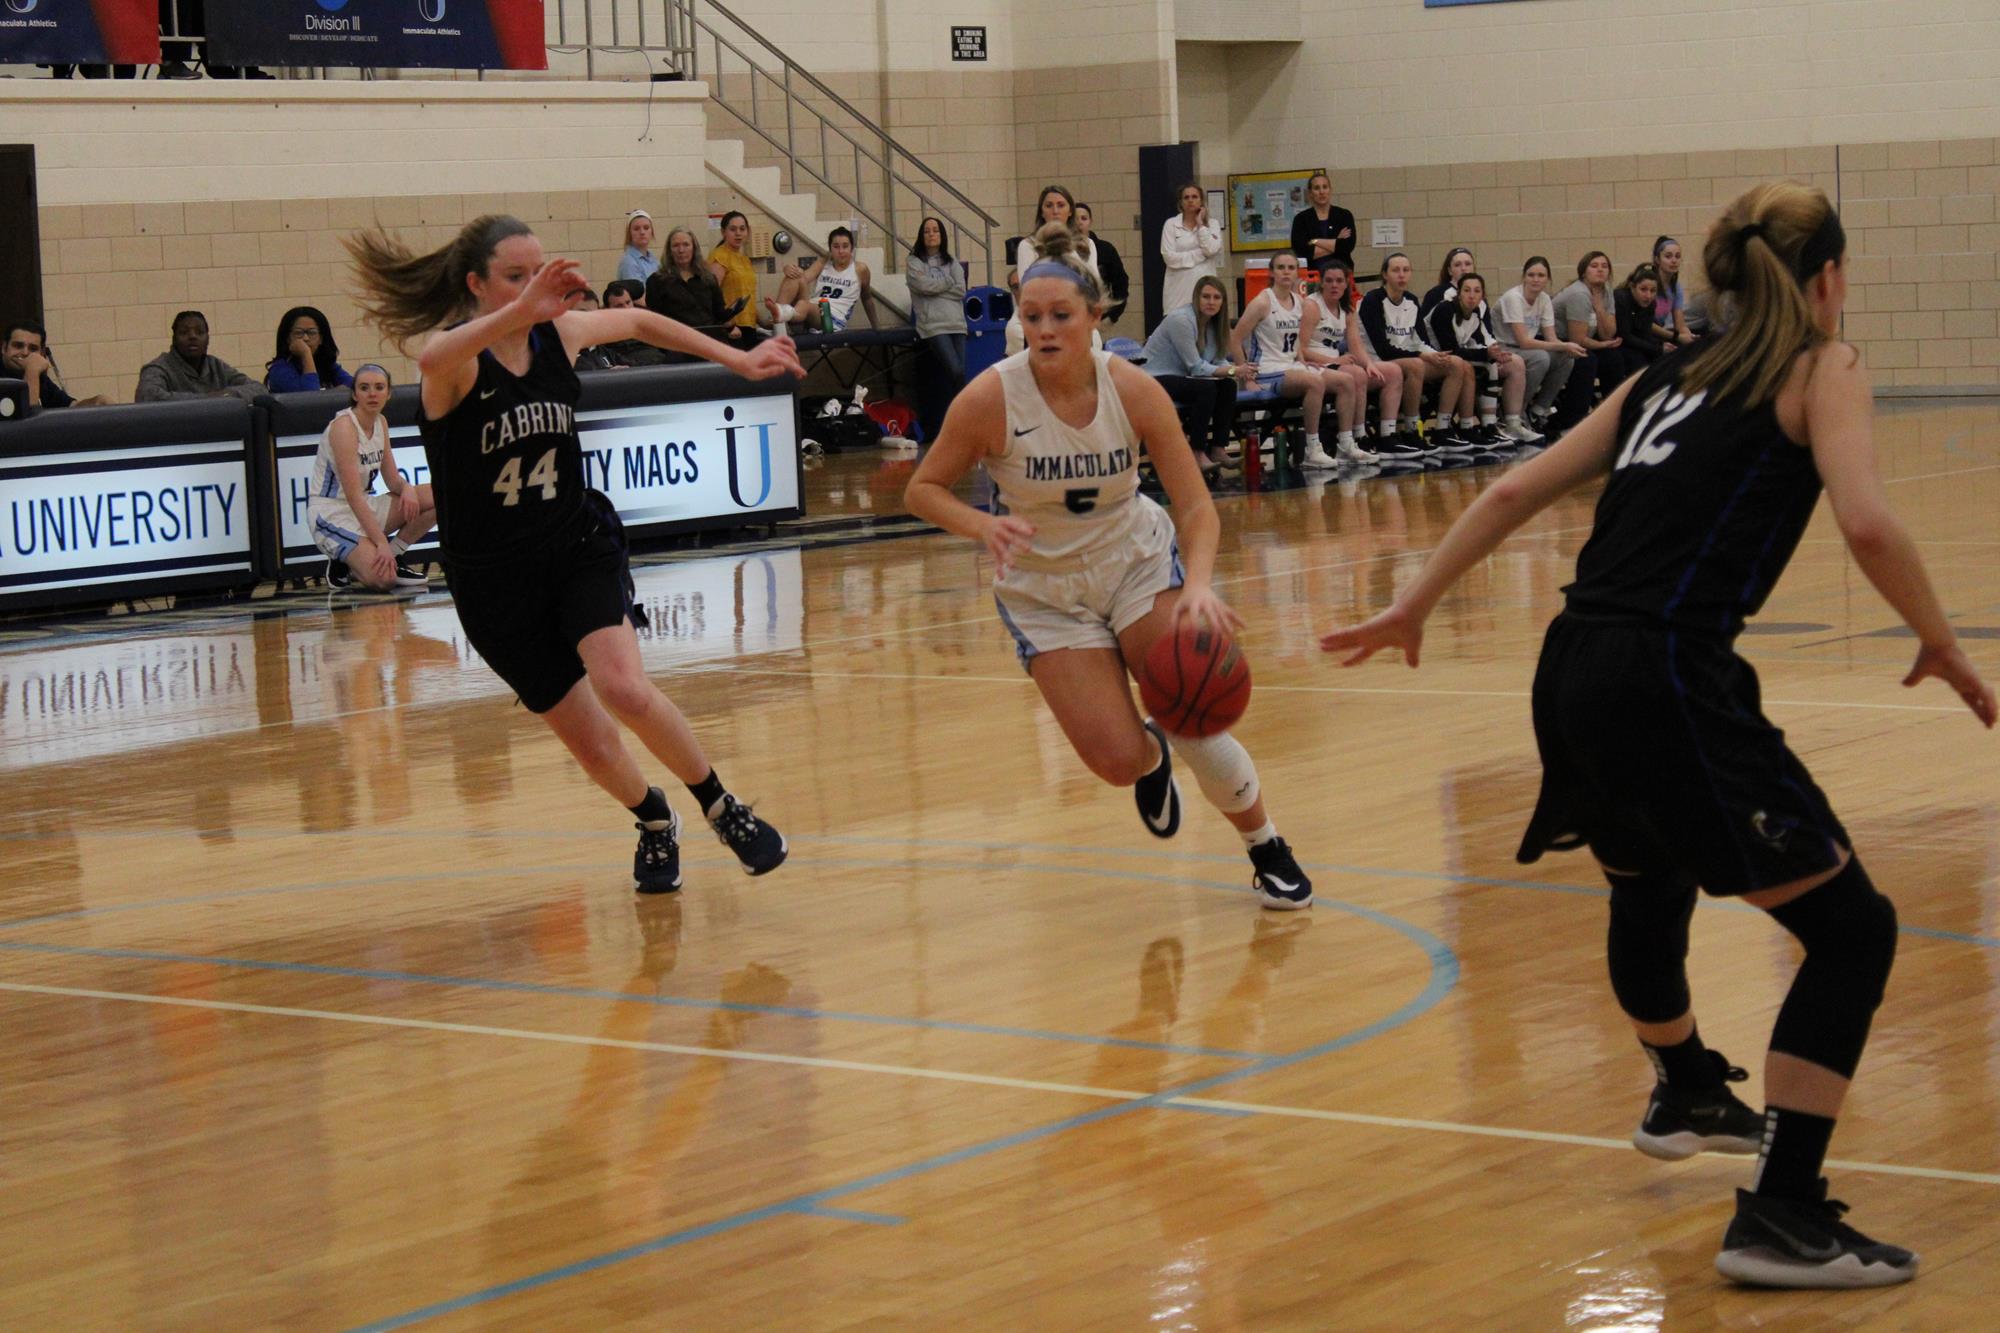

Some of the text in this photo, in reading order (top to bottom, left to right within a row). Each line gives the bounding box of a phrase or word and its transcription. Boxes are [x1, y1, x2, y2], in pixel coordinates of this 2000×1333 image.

[305, 14, 349, 31] Division
[437, 28, 462, 36] Athletics
[1614, 384, 1708, 471] 12
[493, 447, 559, 507] 44
[623, 440, 699, 490] MACS
[12, 482, 237, 556] UNIVERSITY
